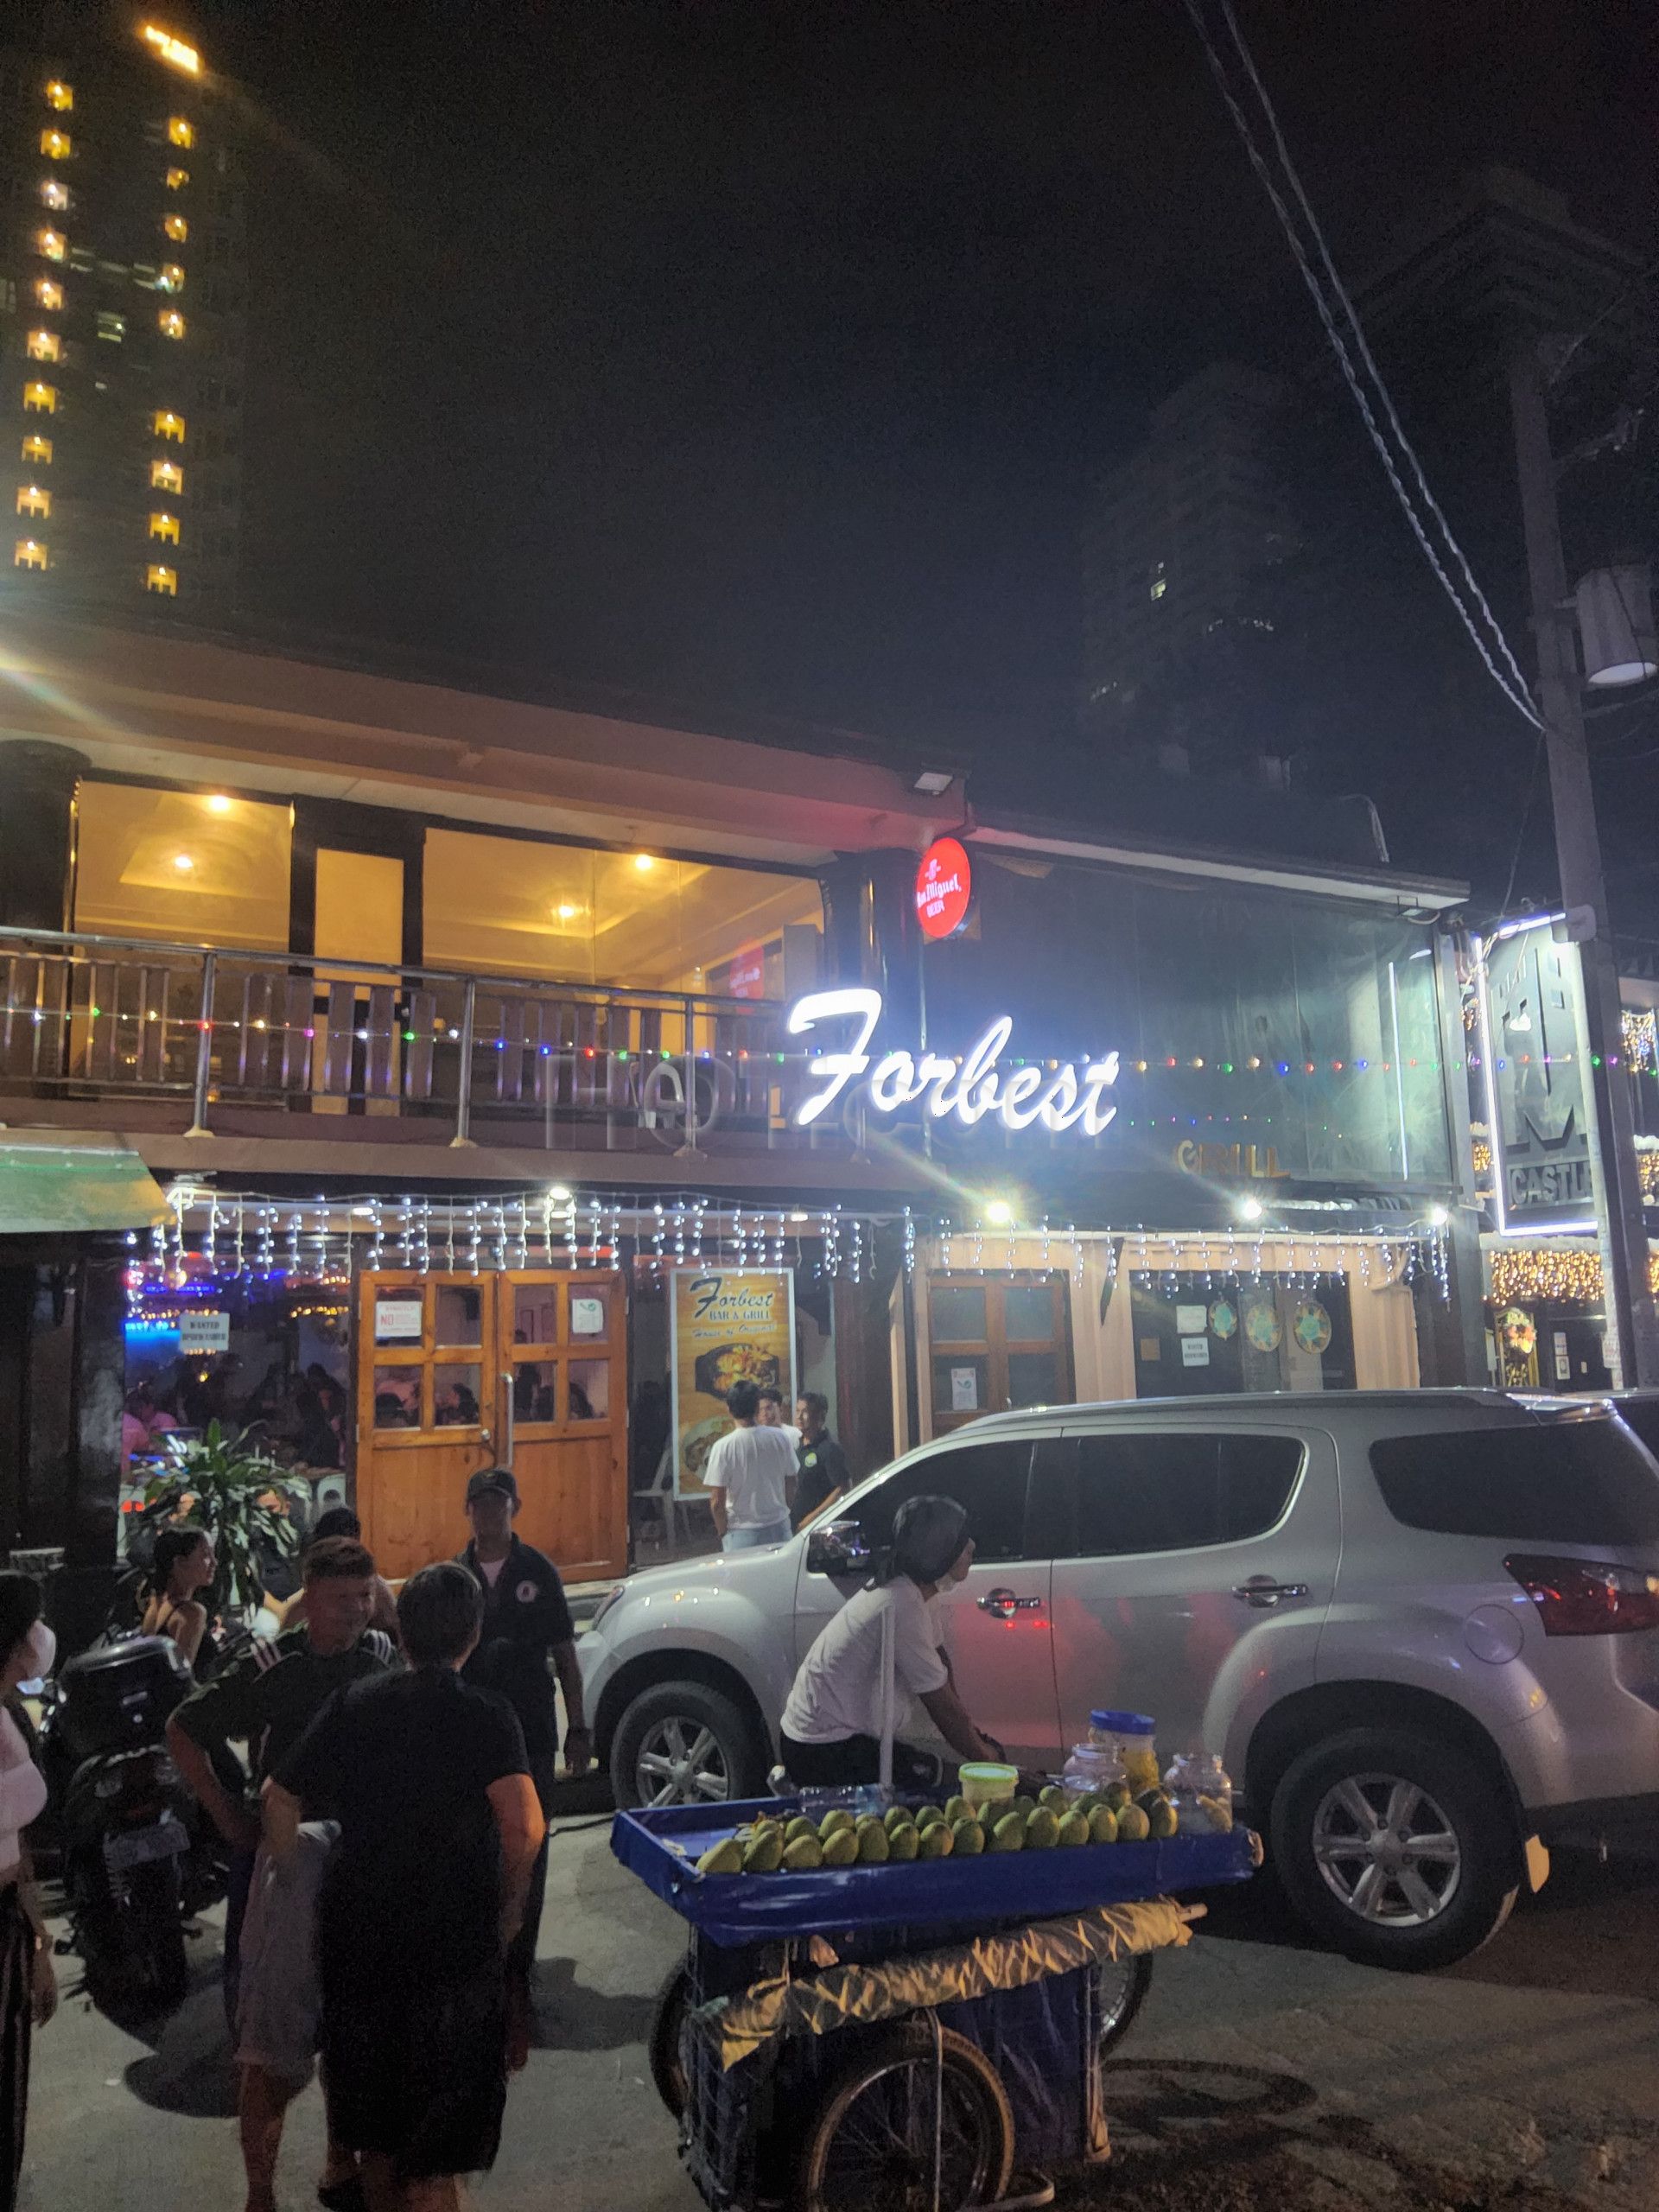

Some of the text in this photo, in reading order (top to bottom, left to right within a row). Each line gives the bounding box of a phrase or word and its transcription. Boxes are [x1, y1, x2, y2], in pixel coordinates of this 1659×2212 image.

[789, 988, 1120, 1136] Forbest
[1175, 1140, 1291, 1178] GRILL
[690, 1276, 774, 1319] Forbest
[709, 1310, 730, 1320] BAR
